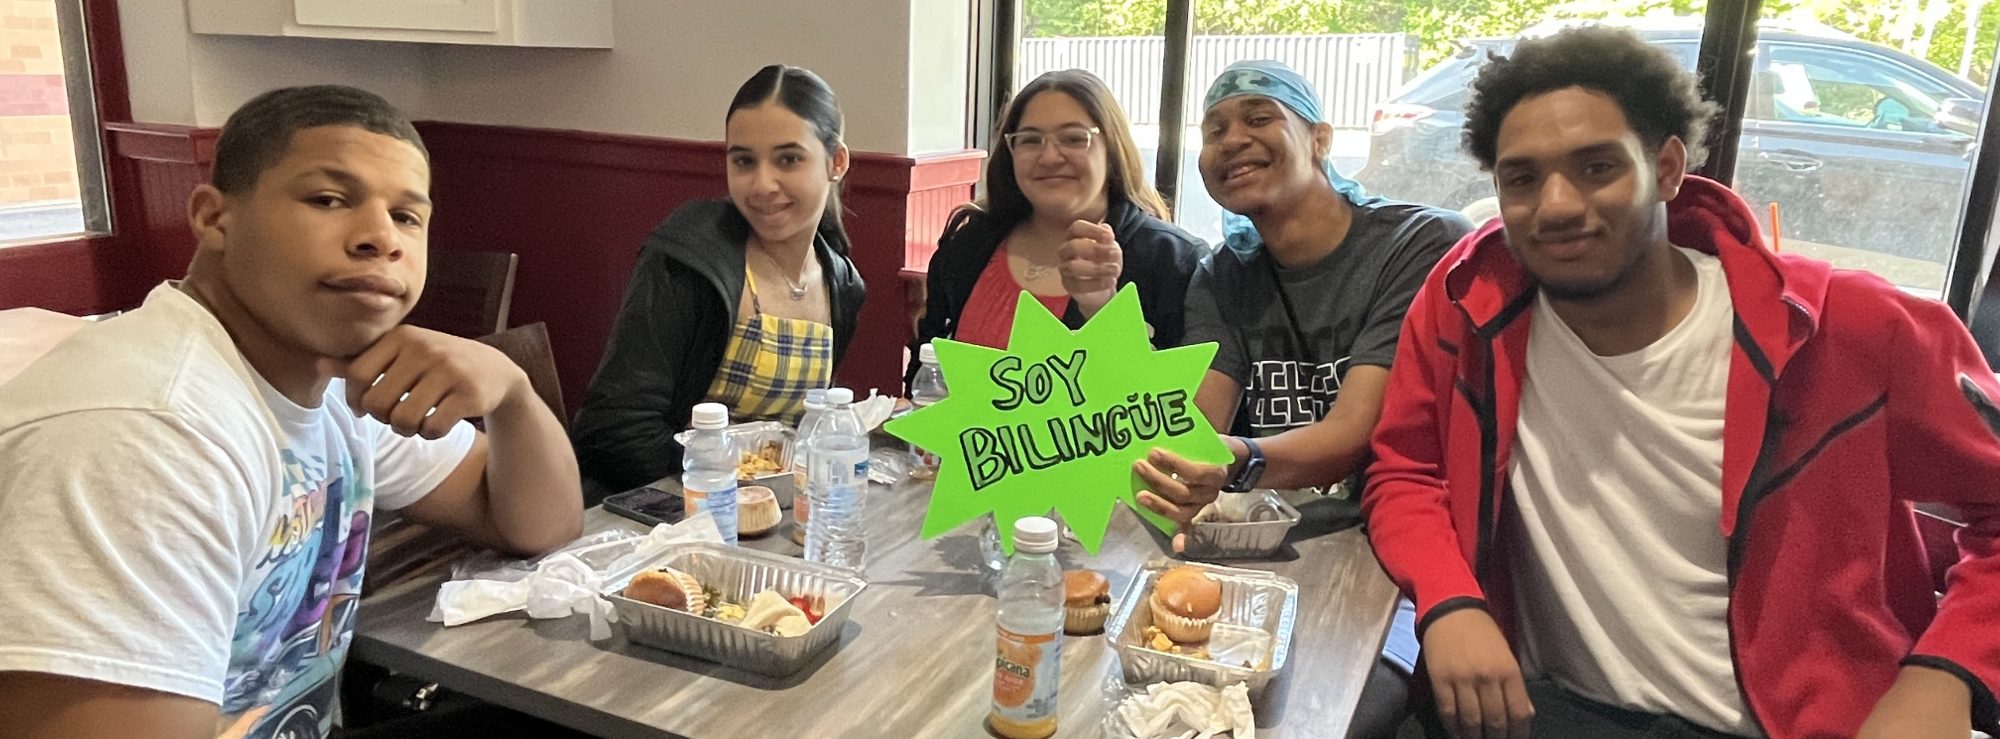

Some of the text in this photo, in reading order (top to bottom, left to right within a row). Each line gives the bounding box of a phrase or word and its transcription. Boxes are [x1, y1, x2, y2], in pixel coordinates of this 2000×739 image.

[990, 350, 1086, 410] SOY
[959, 389, 1195, 491] BILINGÜE
[996, 657, 1030, 678] picana
